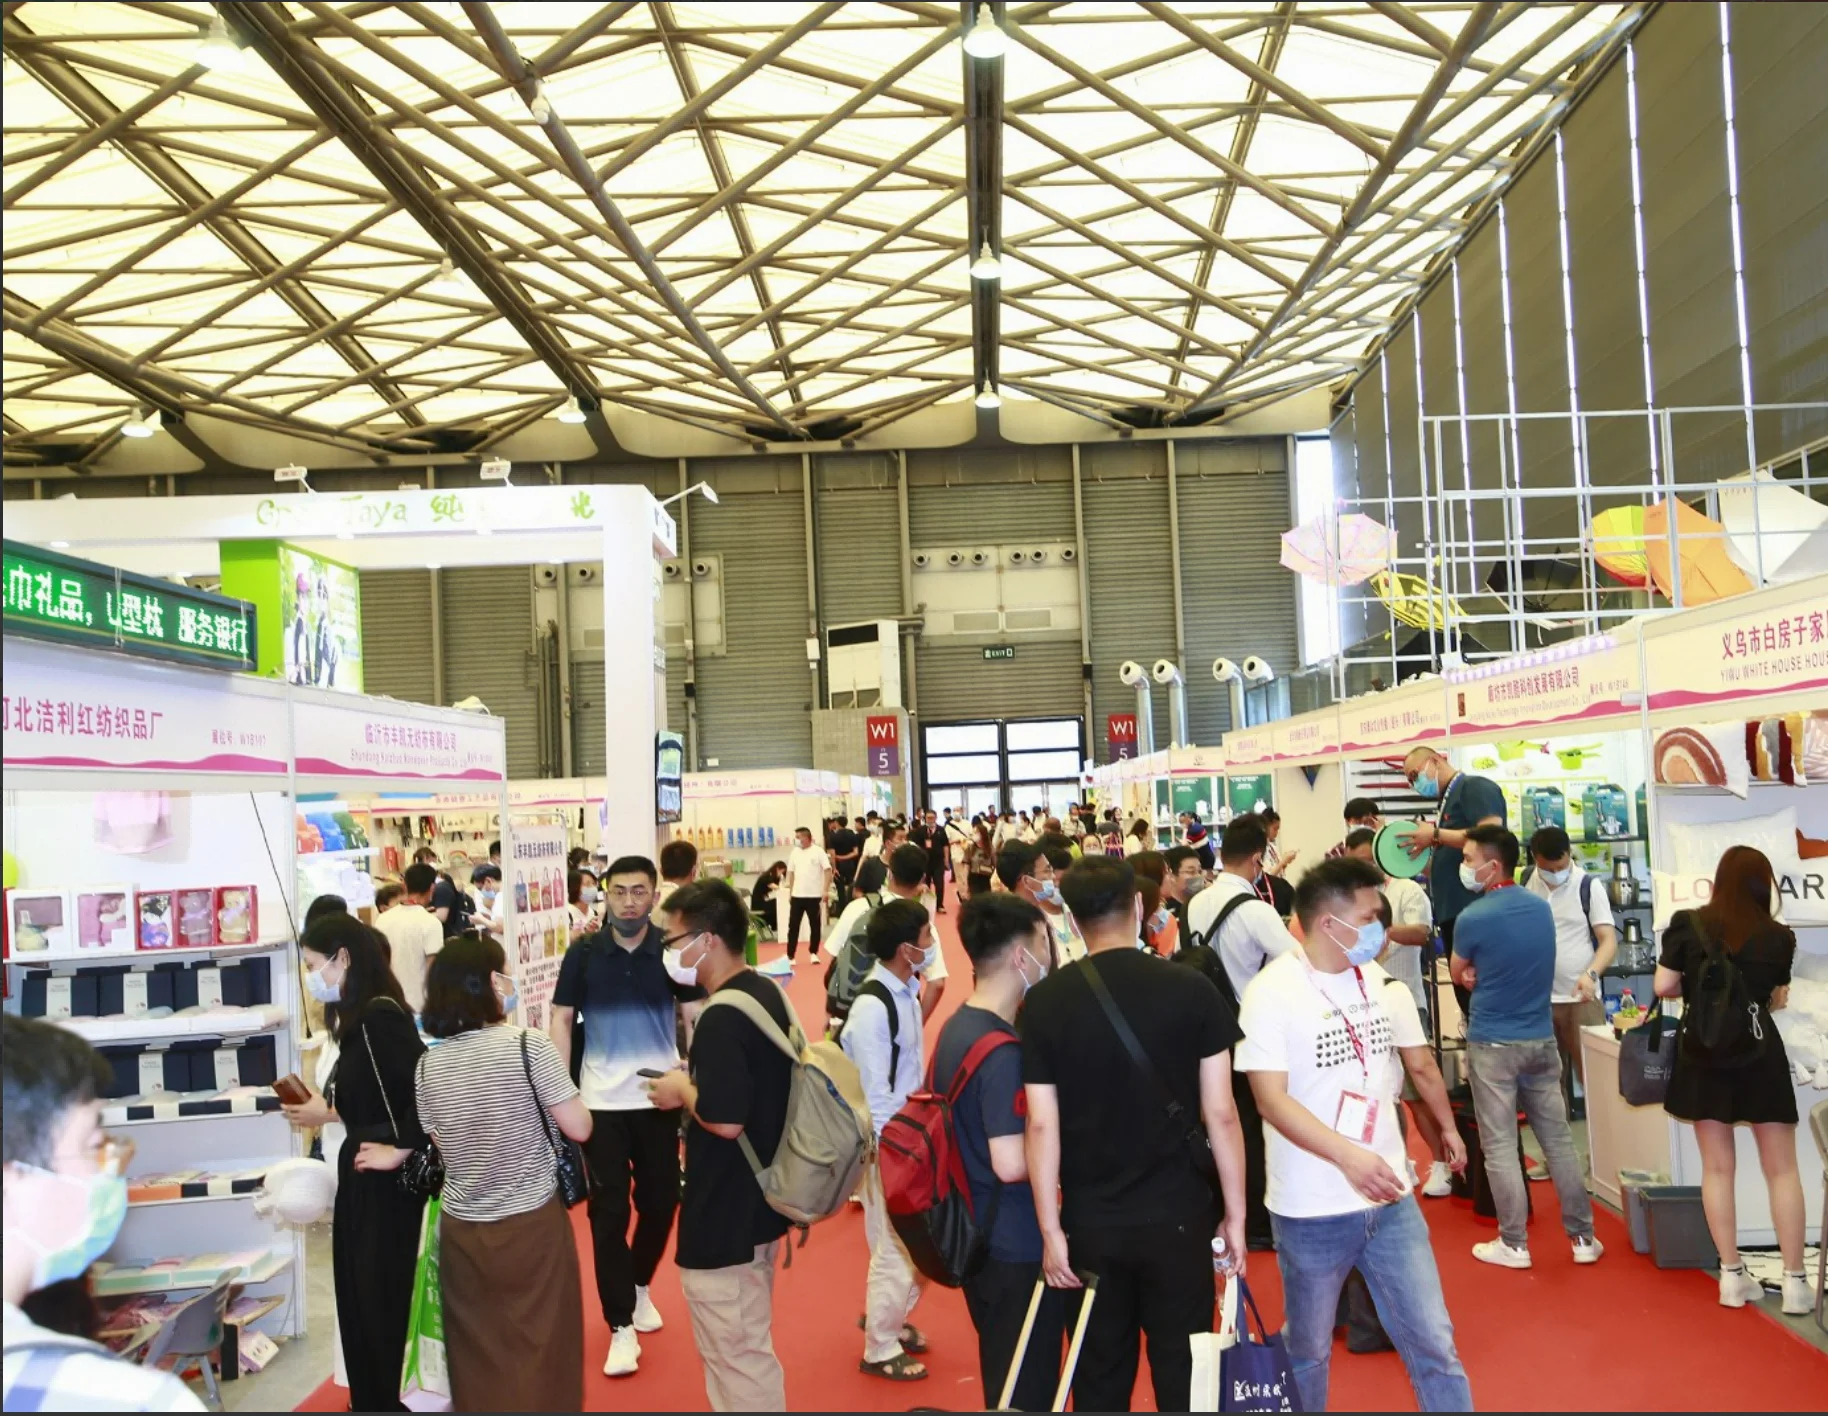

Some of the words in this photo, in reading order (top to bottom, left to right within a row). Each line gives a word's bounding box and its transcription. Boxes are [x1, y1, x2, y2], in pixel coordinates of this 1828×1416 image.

[1722, 609, 1828, 661] 义乌市白房子家
[1743, 661, 1769, 680] WHITE
[1772, 655, 1802, 675] HOUSE
[870, 723, 894, 739] W1
[1111, 721, 1133, 736] W1
[879, 752, 889, 769] 5
[1119, 747, 1128, 761] 5
